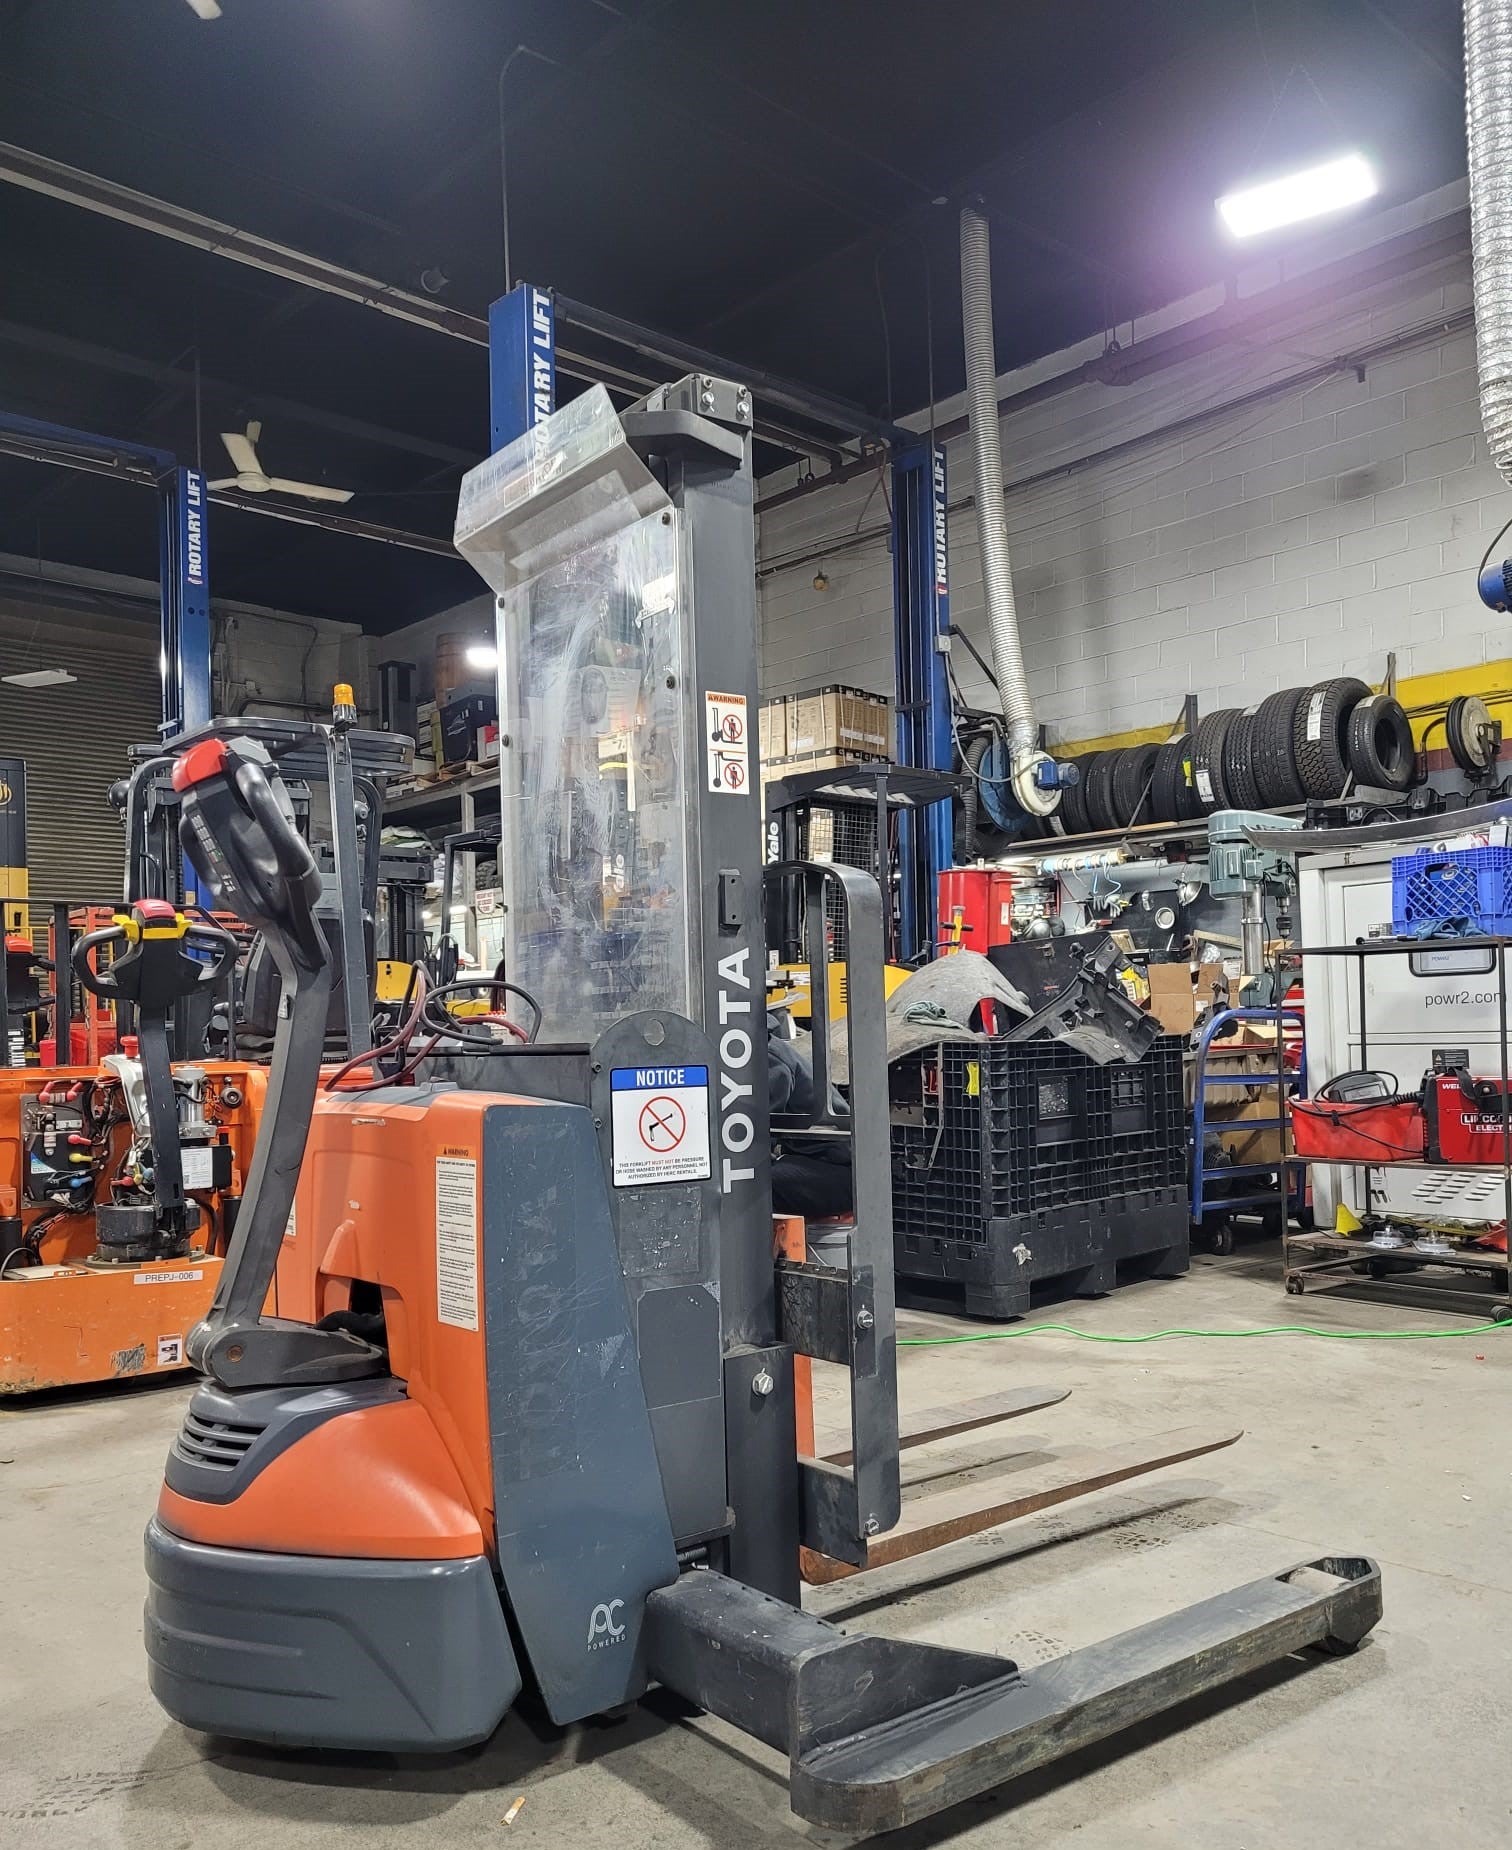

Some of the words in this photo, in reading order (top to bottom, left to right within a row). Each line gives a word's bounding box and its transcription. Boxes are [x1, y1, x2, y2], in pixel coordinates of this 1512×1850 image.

[532, 287, 551, 350] LIFT
[533, 352, 551, 463] ROTARY
[187, 470, 201, 506] LIFT
[187, 508, 202, 577] ROTARY
[712, 694, 745, 705] WARNING
[767, 821, 779, 865] Yale
[636, 1069, 685, 1087] NOTICE
[717, 947, 755, 1194] TOYOTA
[145, 1271, 194, 1283] PREPJ-006
[587, 1598, 626, 1644] AC
[587, 1633, 626, 1653] POWERED
